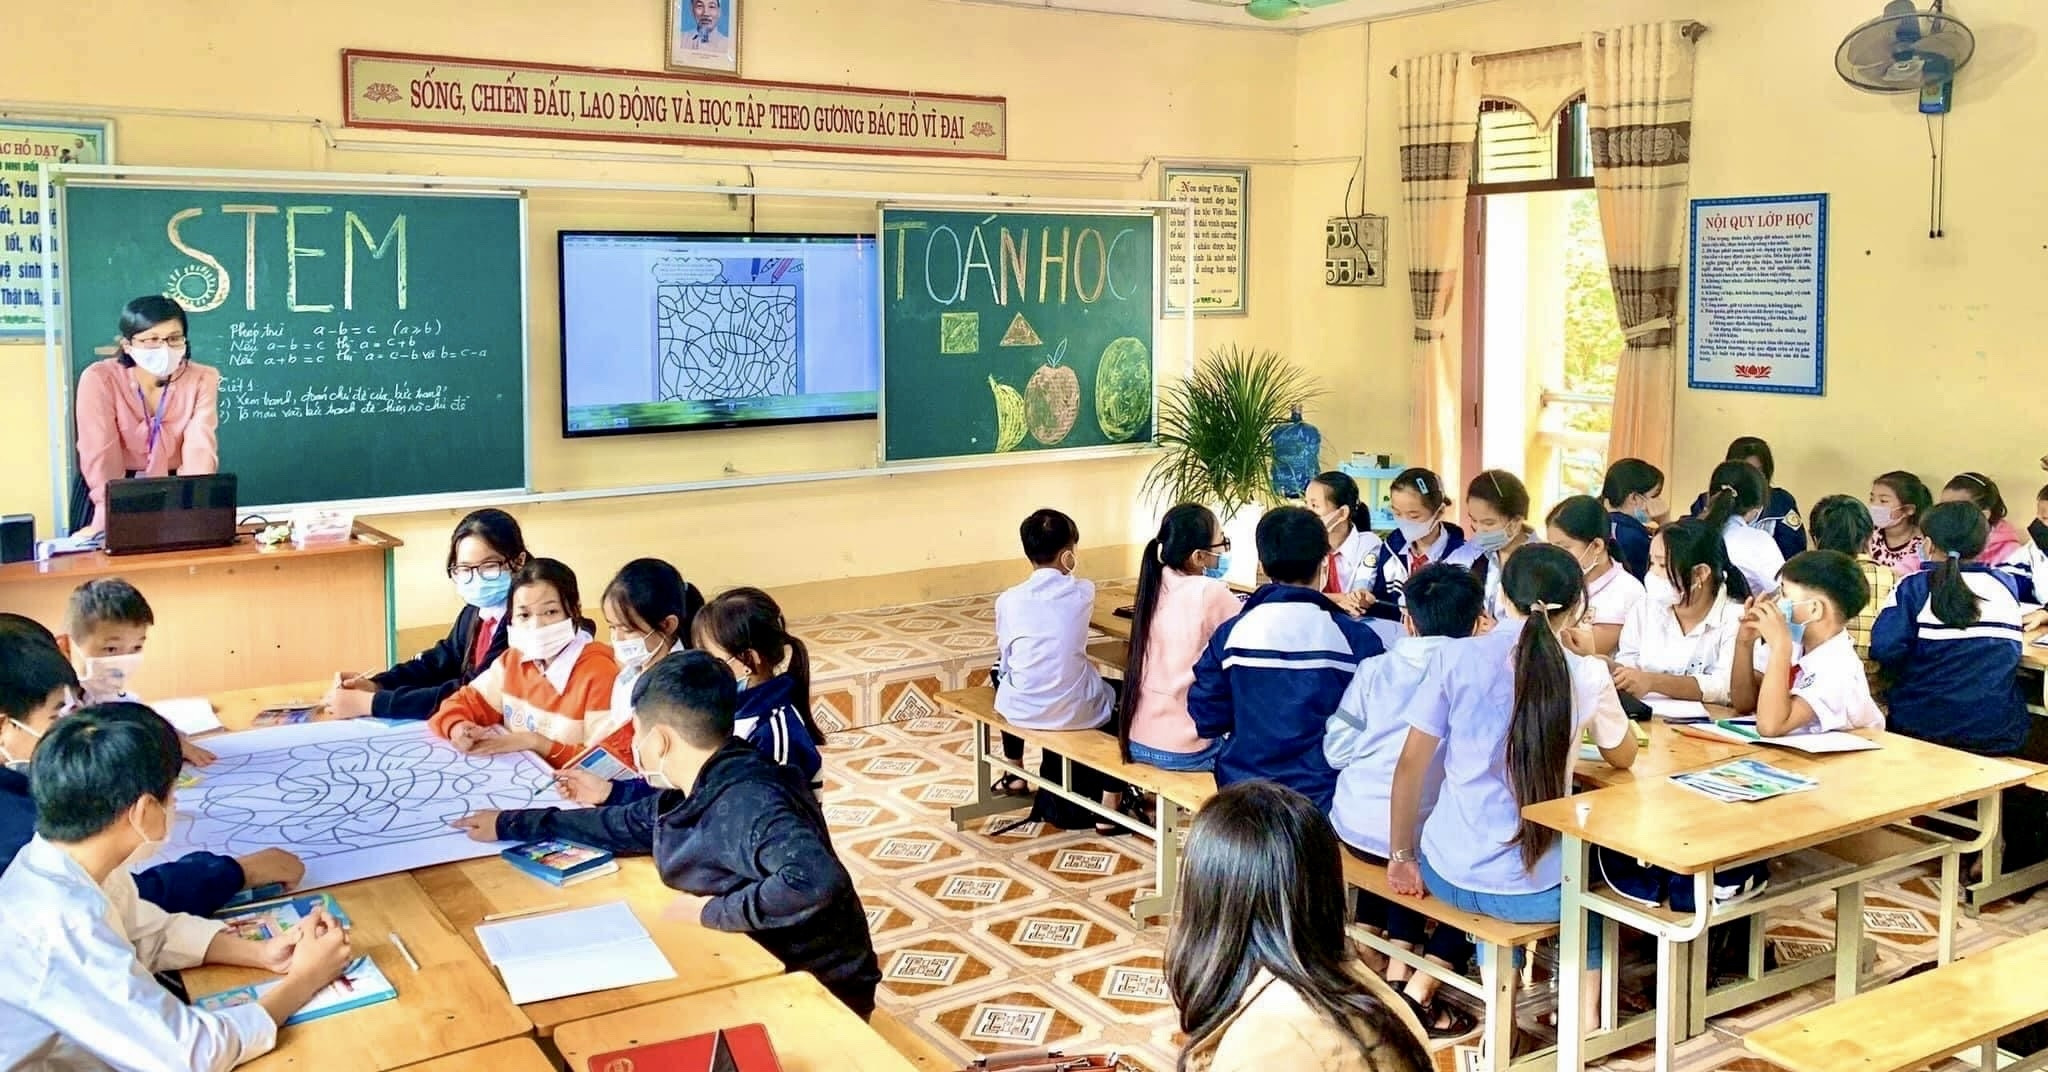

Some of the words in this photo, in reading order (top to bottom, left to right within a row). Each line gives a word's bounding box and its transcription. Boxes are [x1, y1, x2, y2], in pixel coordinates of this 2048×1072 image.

[411, 67, 466, 116] SỐNG,
[472, 72, 528, 114] CHIẾN
[534, 76, 575, 122] ĐẤU,
[580, 91, 615, 119] LAO
[619, 85, 668, 129] ĐỘNG
[672, 90, 695, 124] VÀ
[699, 100, 731, 133] HỌC
[736, 93, 766, 134] TẬP
[770, 104, 810, 131] THEO
[815, 104, 865, 135] GƯƠNG
[869, 104, 896, 137] BÁC
[900, 99, 919, 138] HỒ
[923, 109, 938, 138] VÌ
[942, 115, 965, 146] ĐẠI
[15, 137, 31, 156] HỒ
[34, 144, 60, 160] DẠY
[17, 180, 38, 198] Yêu
[19, 208, 39, 225] Lao
[1705, 213, 1727, 232] NỘI
[1730, 215, 1755, 231] QUY
[1758, 210, 1783, 228] LỚP
[1786, 212, 1814, 230] HỌC
[6, 232, 23, 254] tốt,
[163, 204, 407, 313] STEM
[884, 214, 1029, 306] TOÁN
[19, 262, 42, 279] sinh
[1, 287, 22, 309] Thật
[24, 287, 43, 307] thà,
